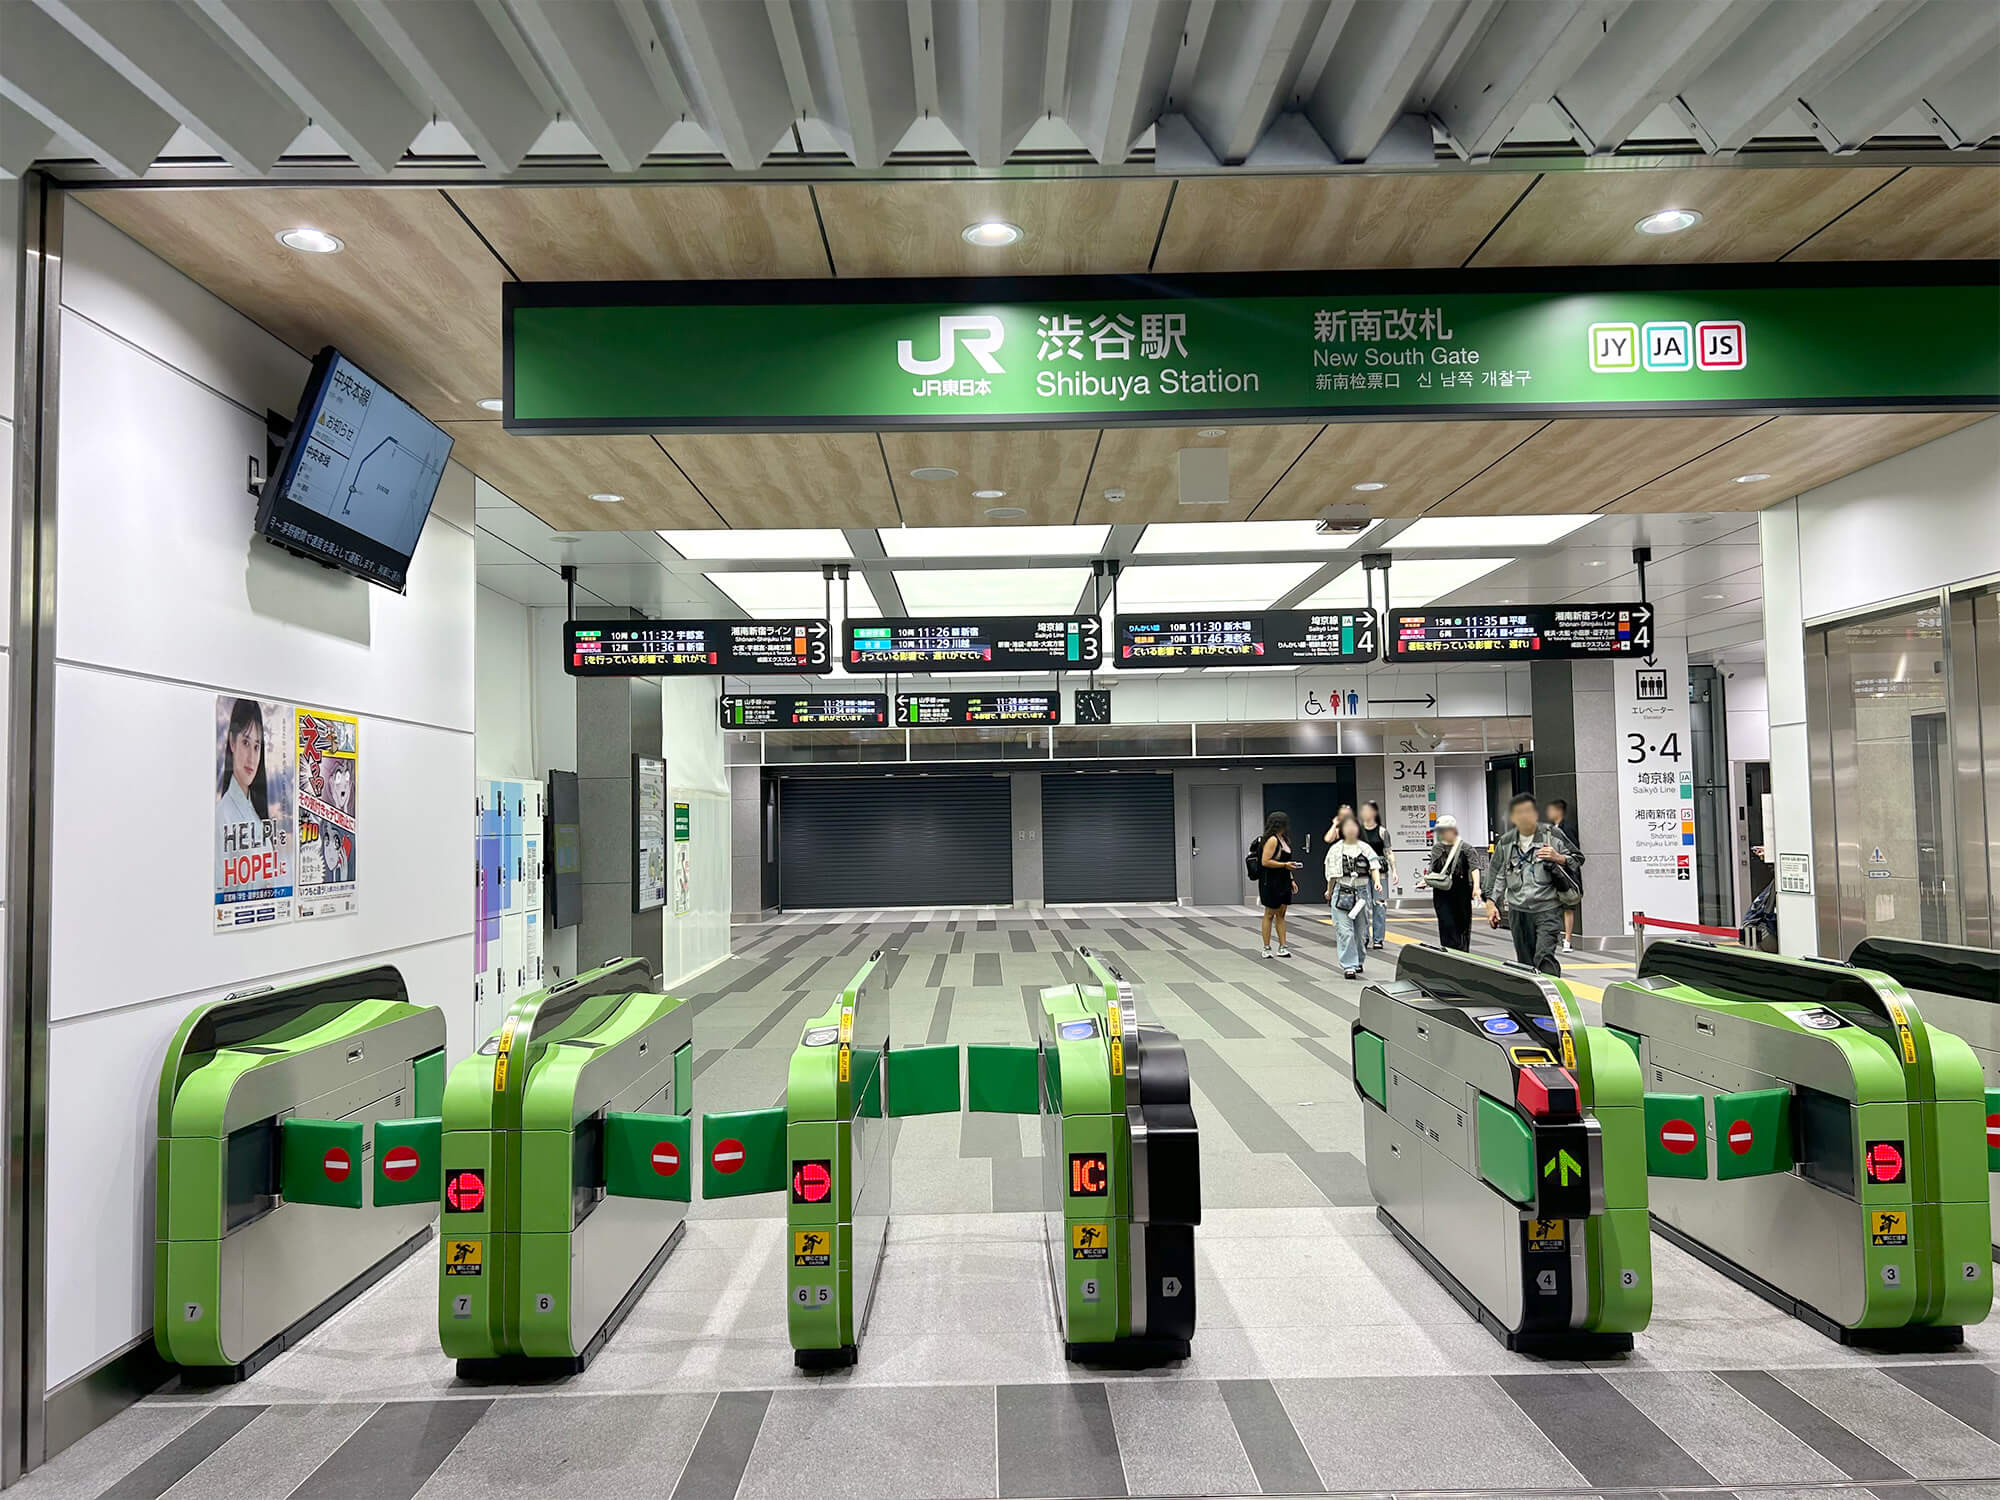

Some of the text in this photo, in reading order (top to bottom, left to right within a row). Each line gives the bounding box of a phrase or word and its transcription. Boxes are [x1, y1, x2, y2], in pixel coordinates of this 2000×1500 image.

[1313, 308, 1453, 342] 新南改札
[1036, 313, 1188, 360] 渋谷駅
[898, 315, 1006, 376] JR
[1600, 338, 1627, 358] JY
[1653, 337, 1681, 357] JA
[1709, 336, 1733, 356] JS
[1313, 346, 1480, 367] New South Gate
[1036, 368, 1260, 401] Shibuya Station
[1315, 372, 1400, 391] 新南检票口
[1416, 369, 1532, 388] 신 남쪽 개찰구
[334, 369, 371, 407] 中央本線
[912, 379, 992, 398] JR東日本
[1465, 616, 1497, 626] 11:35
[642, 630, 674, 641] 11:32
[1465, 628, 1497, 638] 11:44
[1634, 626, 1651, 649] 4
[642, 642, 675, 652] 11:36
[1083, 637, 1098, 660] 3
[1357, 631, 1374, 653] 4
[1408, 640, 1530, 651] 運転を行っている影響で、遅れ
[811, 641, 826, 664] 3
[724, 709, 731, 724] 1
[898, 707, 908, 722] 2
[1631, 706, 1674, 714] エレベーター
[1638, 771, 1675, 784] 埼京線
[1635, 808, 1677, 820] 湘南新宿
[1648, 821, 1677, 831] ライン
[1073, 1160, 1105, 1192] IC
[1623, 1273, 1632, 1284] 3
[1887, 1268, 1896, 1280] 3
[1965, 1266, 1974, 1277] 2
[1166, 1281, 1175, 1292] 4
[1543, 1274, 1552, 1285] 4
[798, 1289, 828, 1301] 6 5
[1087, 1282, 1095, 1294] 5
[459, 1298, 467, 1310] 7
[540, 1297, 548, 1309] 6
[188, 1305, 197, 1318] 7
